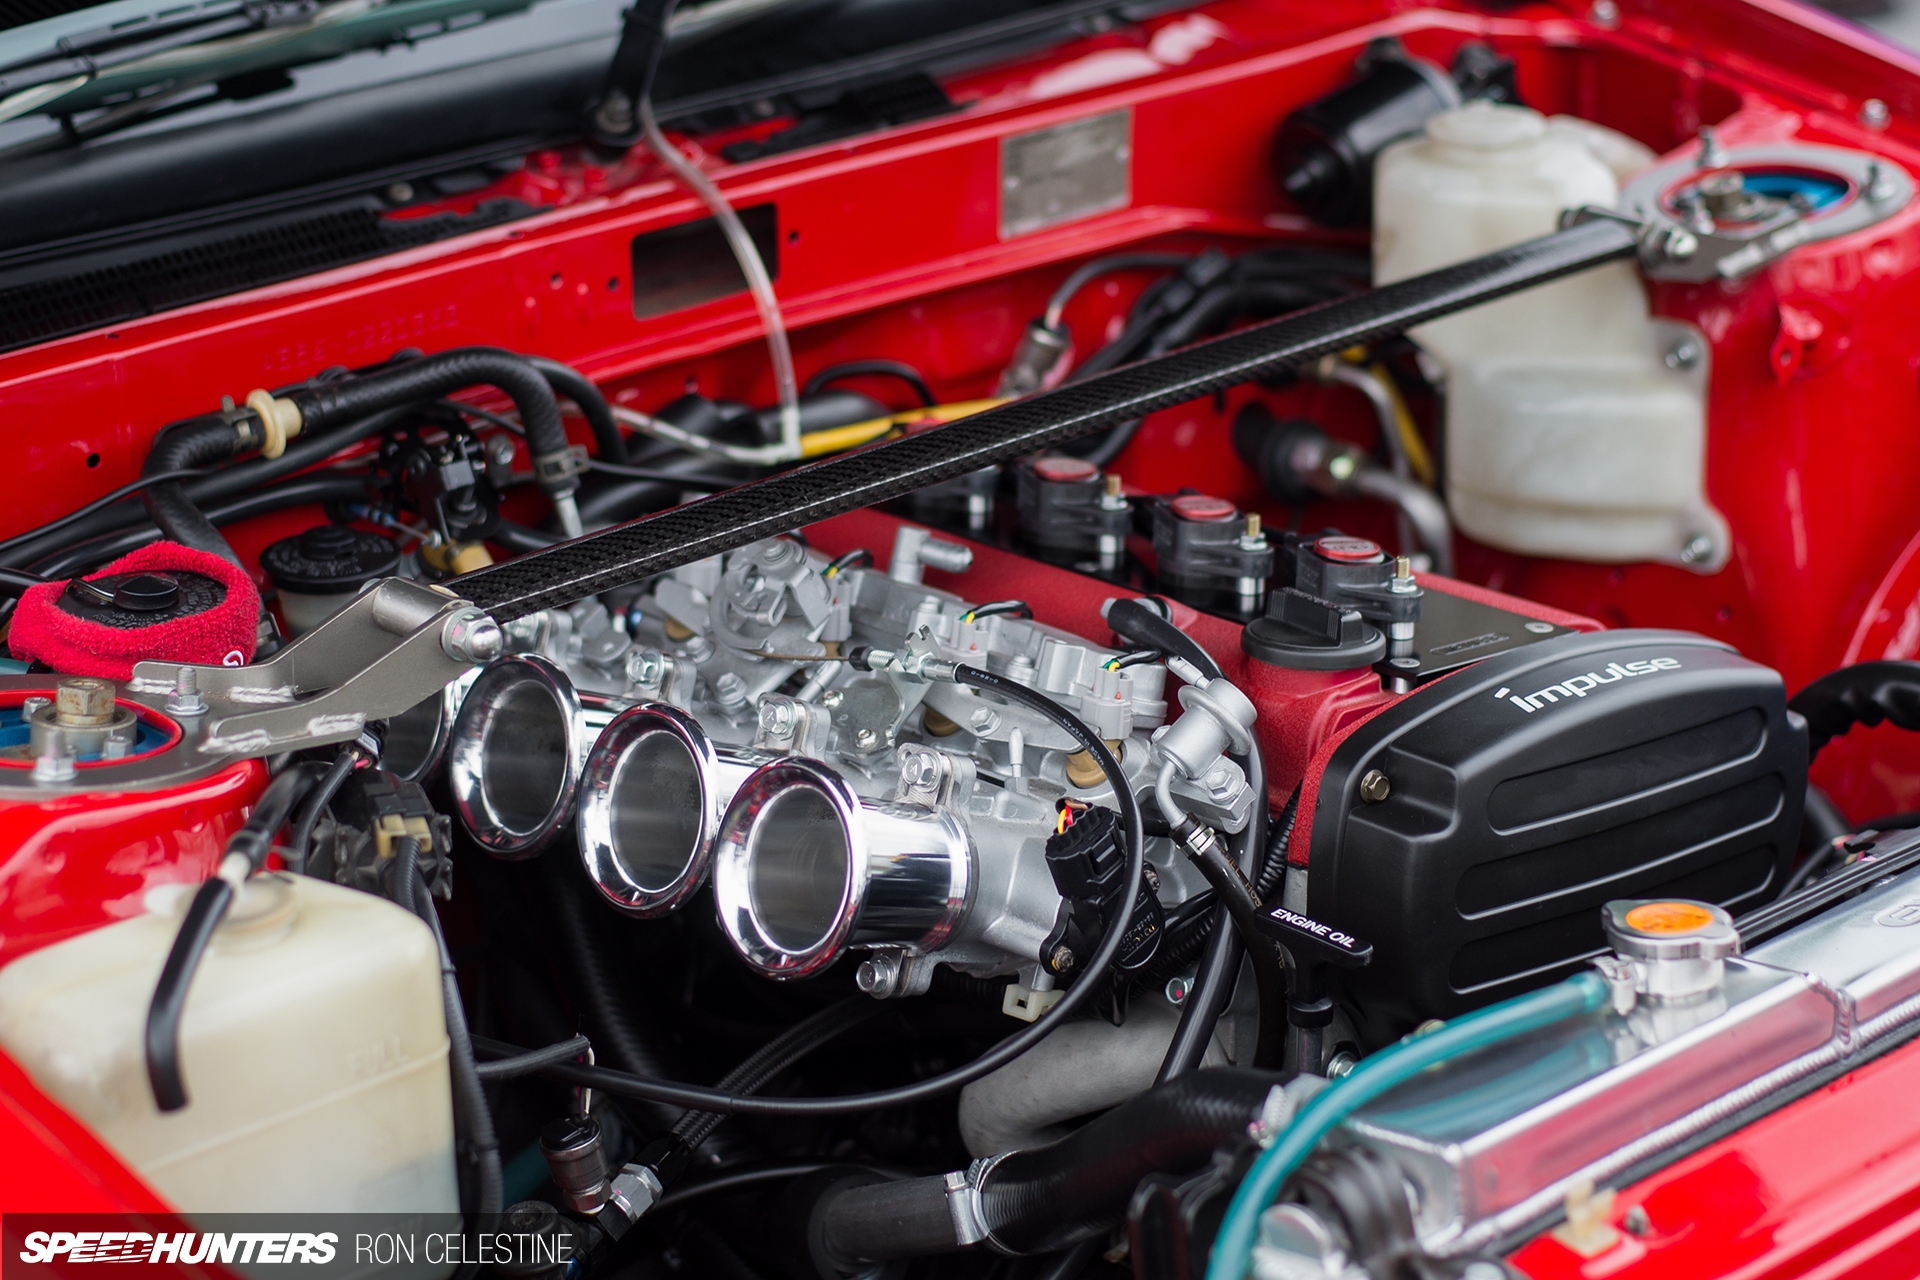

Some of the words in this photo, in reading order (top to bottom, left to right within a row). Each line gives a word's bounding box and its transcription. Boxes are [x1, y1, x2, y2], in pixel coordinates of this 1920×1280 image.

[1062, 717, 1084, 738] JAPAN
[1244, 881, 1263, 907] HOS
[1270, 908, 1332, 936] ENGINE
[1328, 931, 1355, 948] OIL
